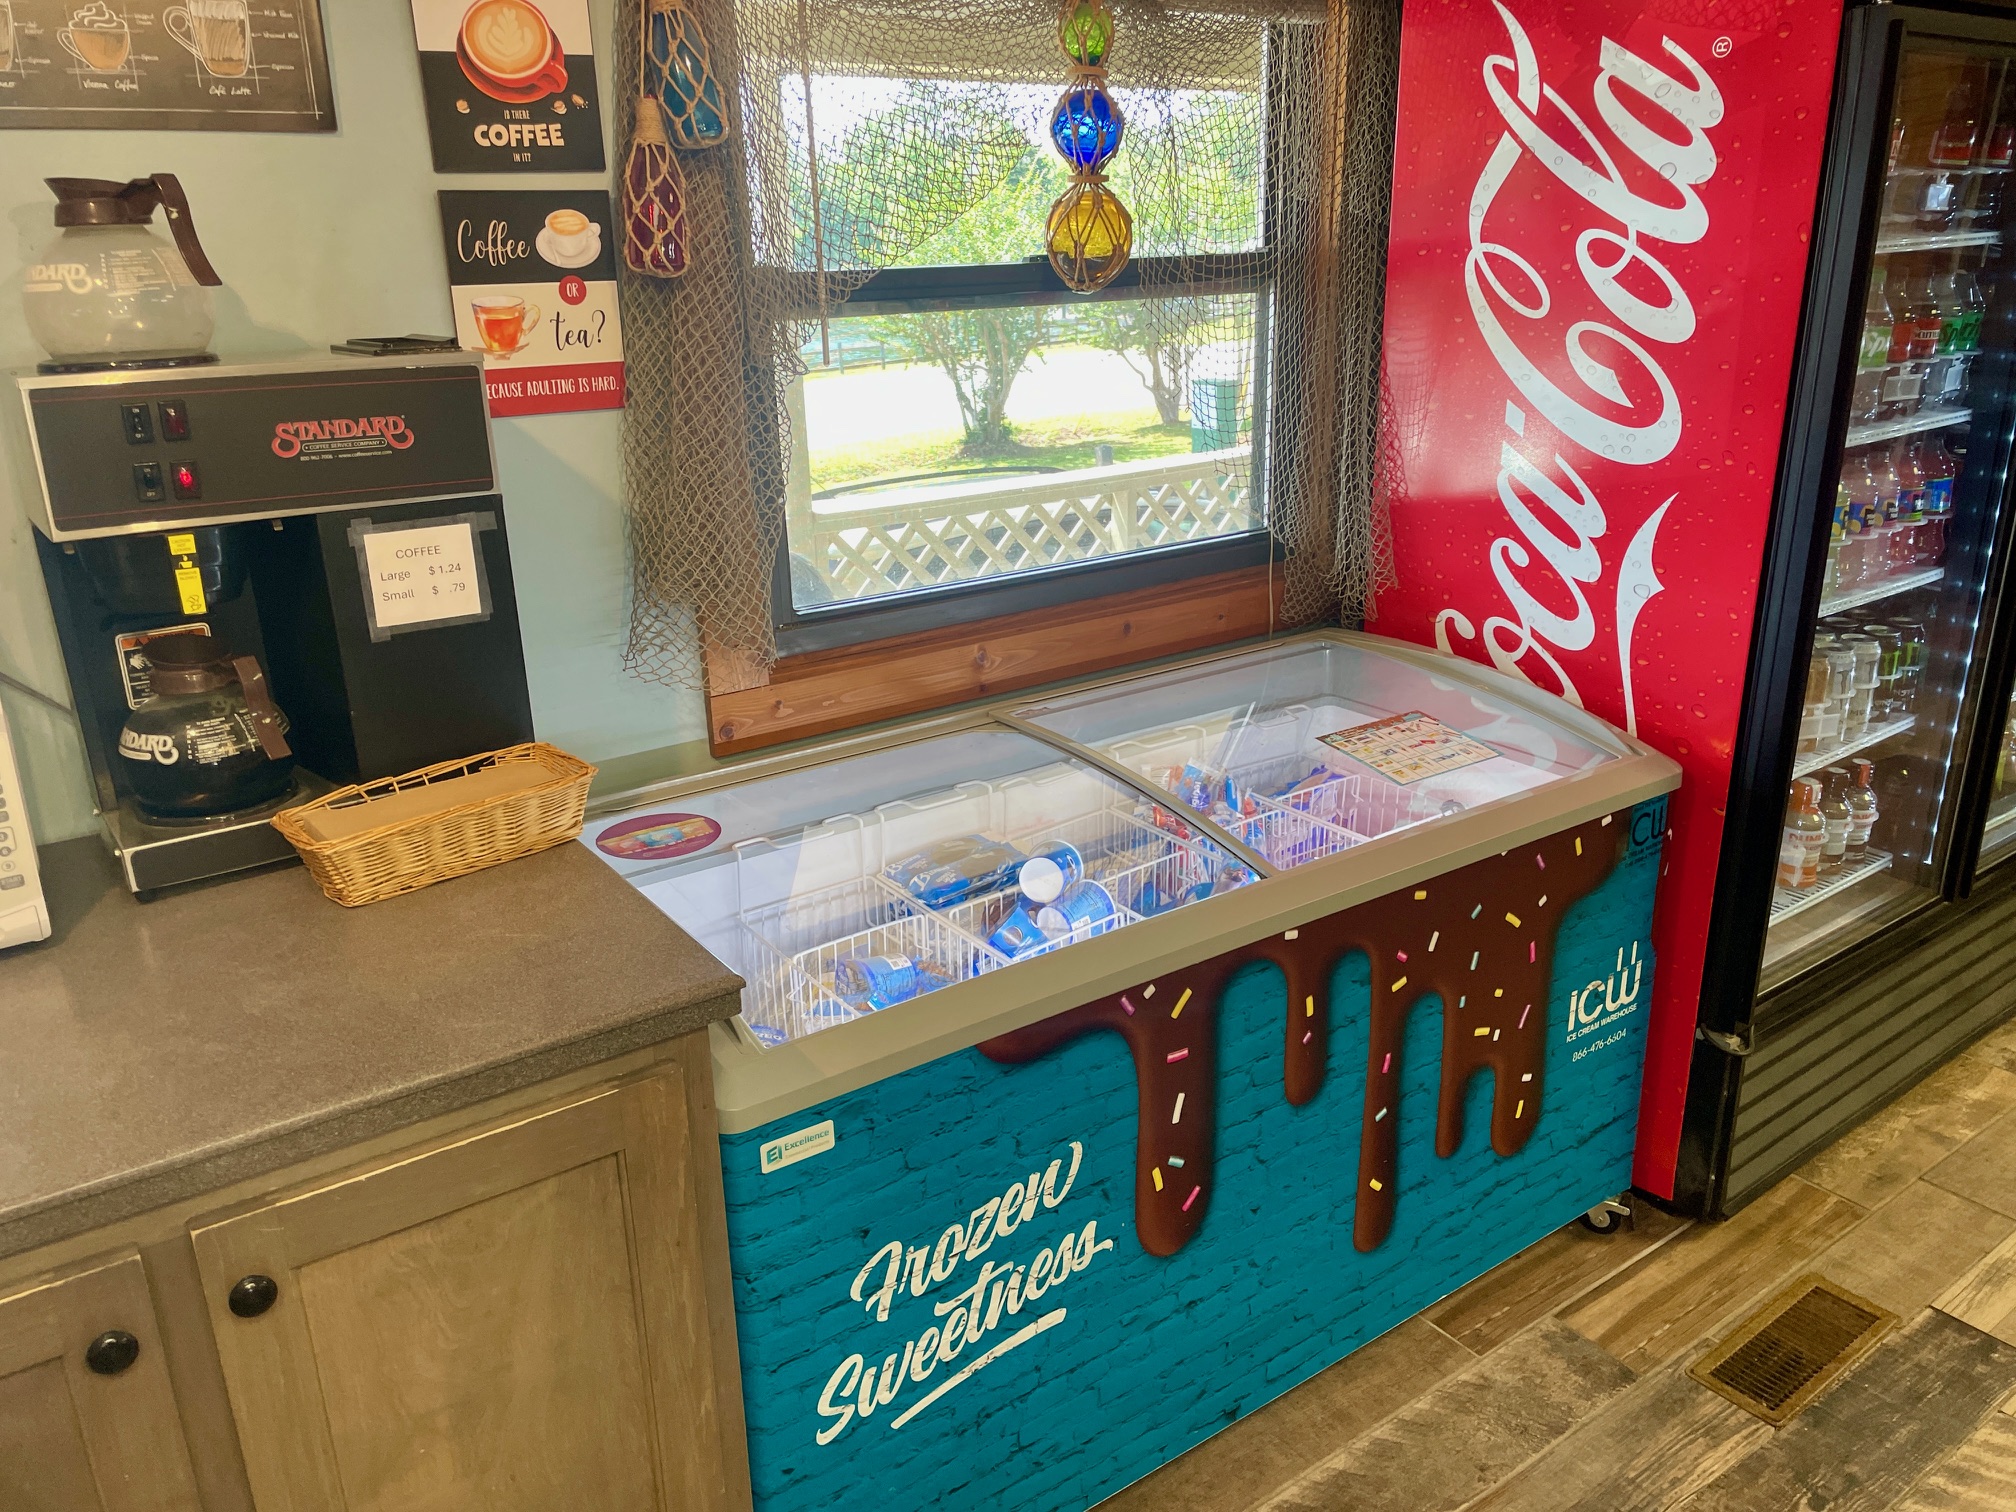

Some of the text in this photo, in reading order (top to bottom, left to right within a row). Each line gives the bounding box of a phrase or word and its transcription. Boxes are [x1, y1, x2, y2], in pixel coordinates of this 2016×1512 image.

[511, 109, 531, 120] THERE
[473, 122, 565, 148] COFFEE
[457, 219, 531, 267] Coffee
[566, 282, 579, 298] OR
[550, 309, 606, 351] tea?
[486, 375, 620, 400] ECAUSE ADULTING IS HARD.
[271, 415, 415, 459] STANDARD
[309, 440, 380, 451] COFFEE SERVICE COMPANY
[395, 545, 442, 559] COFFEE
[380, 570, 411, 582] Large
[382, 582, 466, 602] Small $ .79
[1565, 1002, 1638, 1044] ICE CREAM WAREHOUSE
[784, 1129, 830, 1151] Excellence
[850, 1141, 1083, 1322] Frozen
[816, 1220, 1114, 1446] Sweetness
